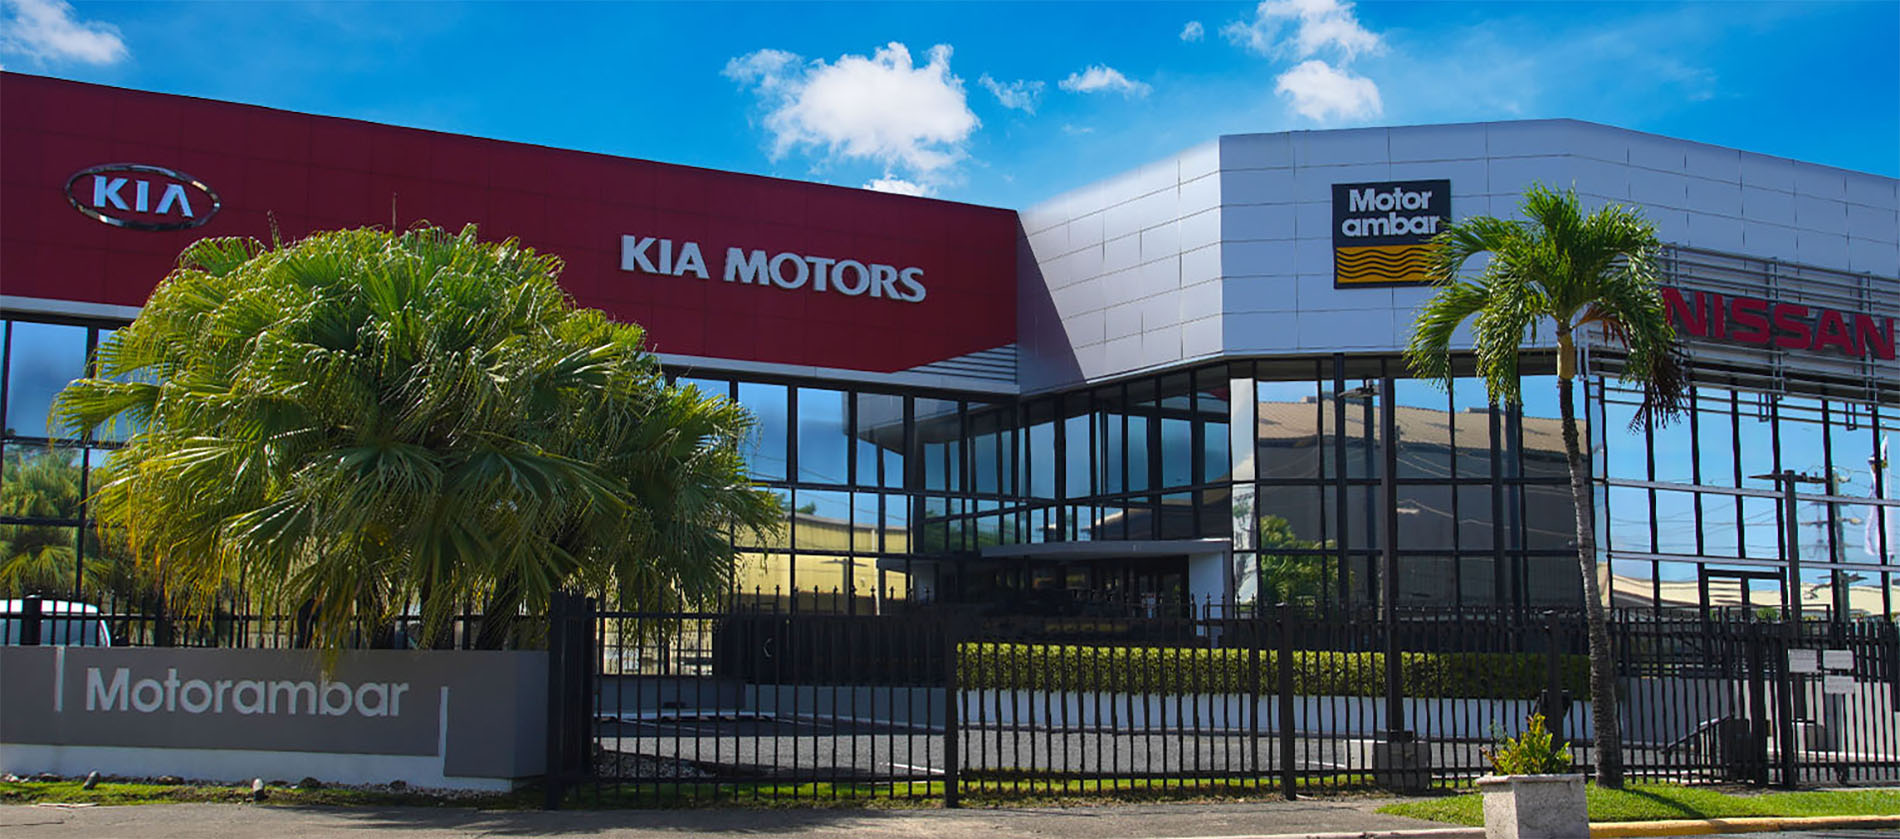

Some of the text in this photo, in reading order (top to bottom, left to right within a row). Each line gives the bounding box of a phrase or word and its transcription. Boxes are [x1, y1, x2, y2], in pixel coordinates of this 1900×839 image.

[93, 174, 194, 218] KIA
[1349, 186, 1432, 212] Motor
[1341, 211, 1440, 237] ambar
[620, 233, 927, 303] KIA MOTORS
[1661, 287, 1896, 361] NISSAN
[86, 667, 410, 717] Motorambar
